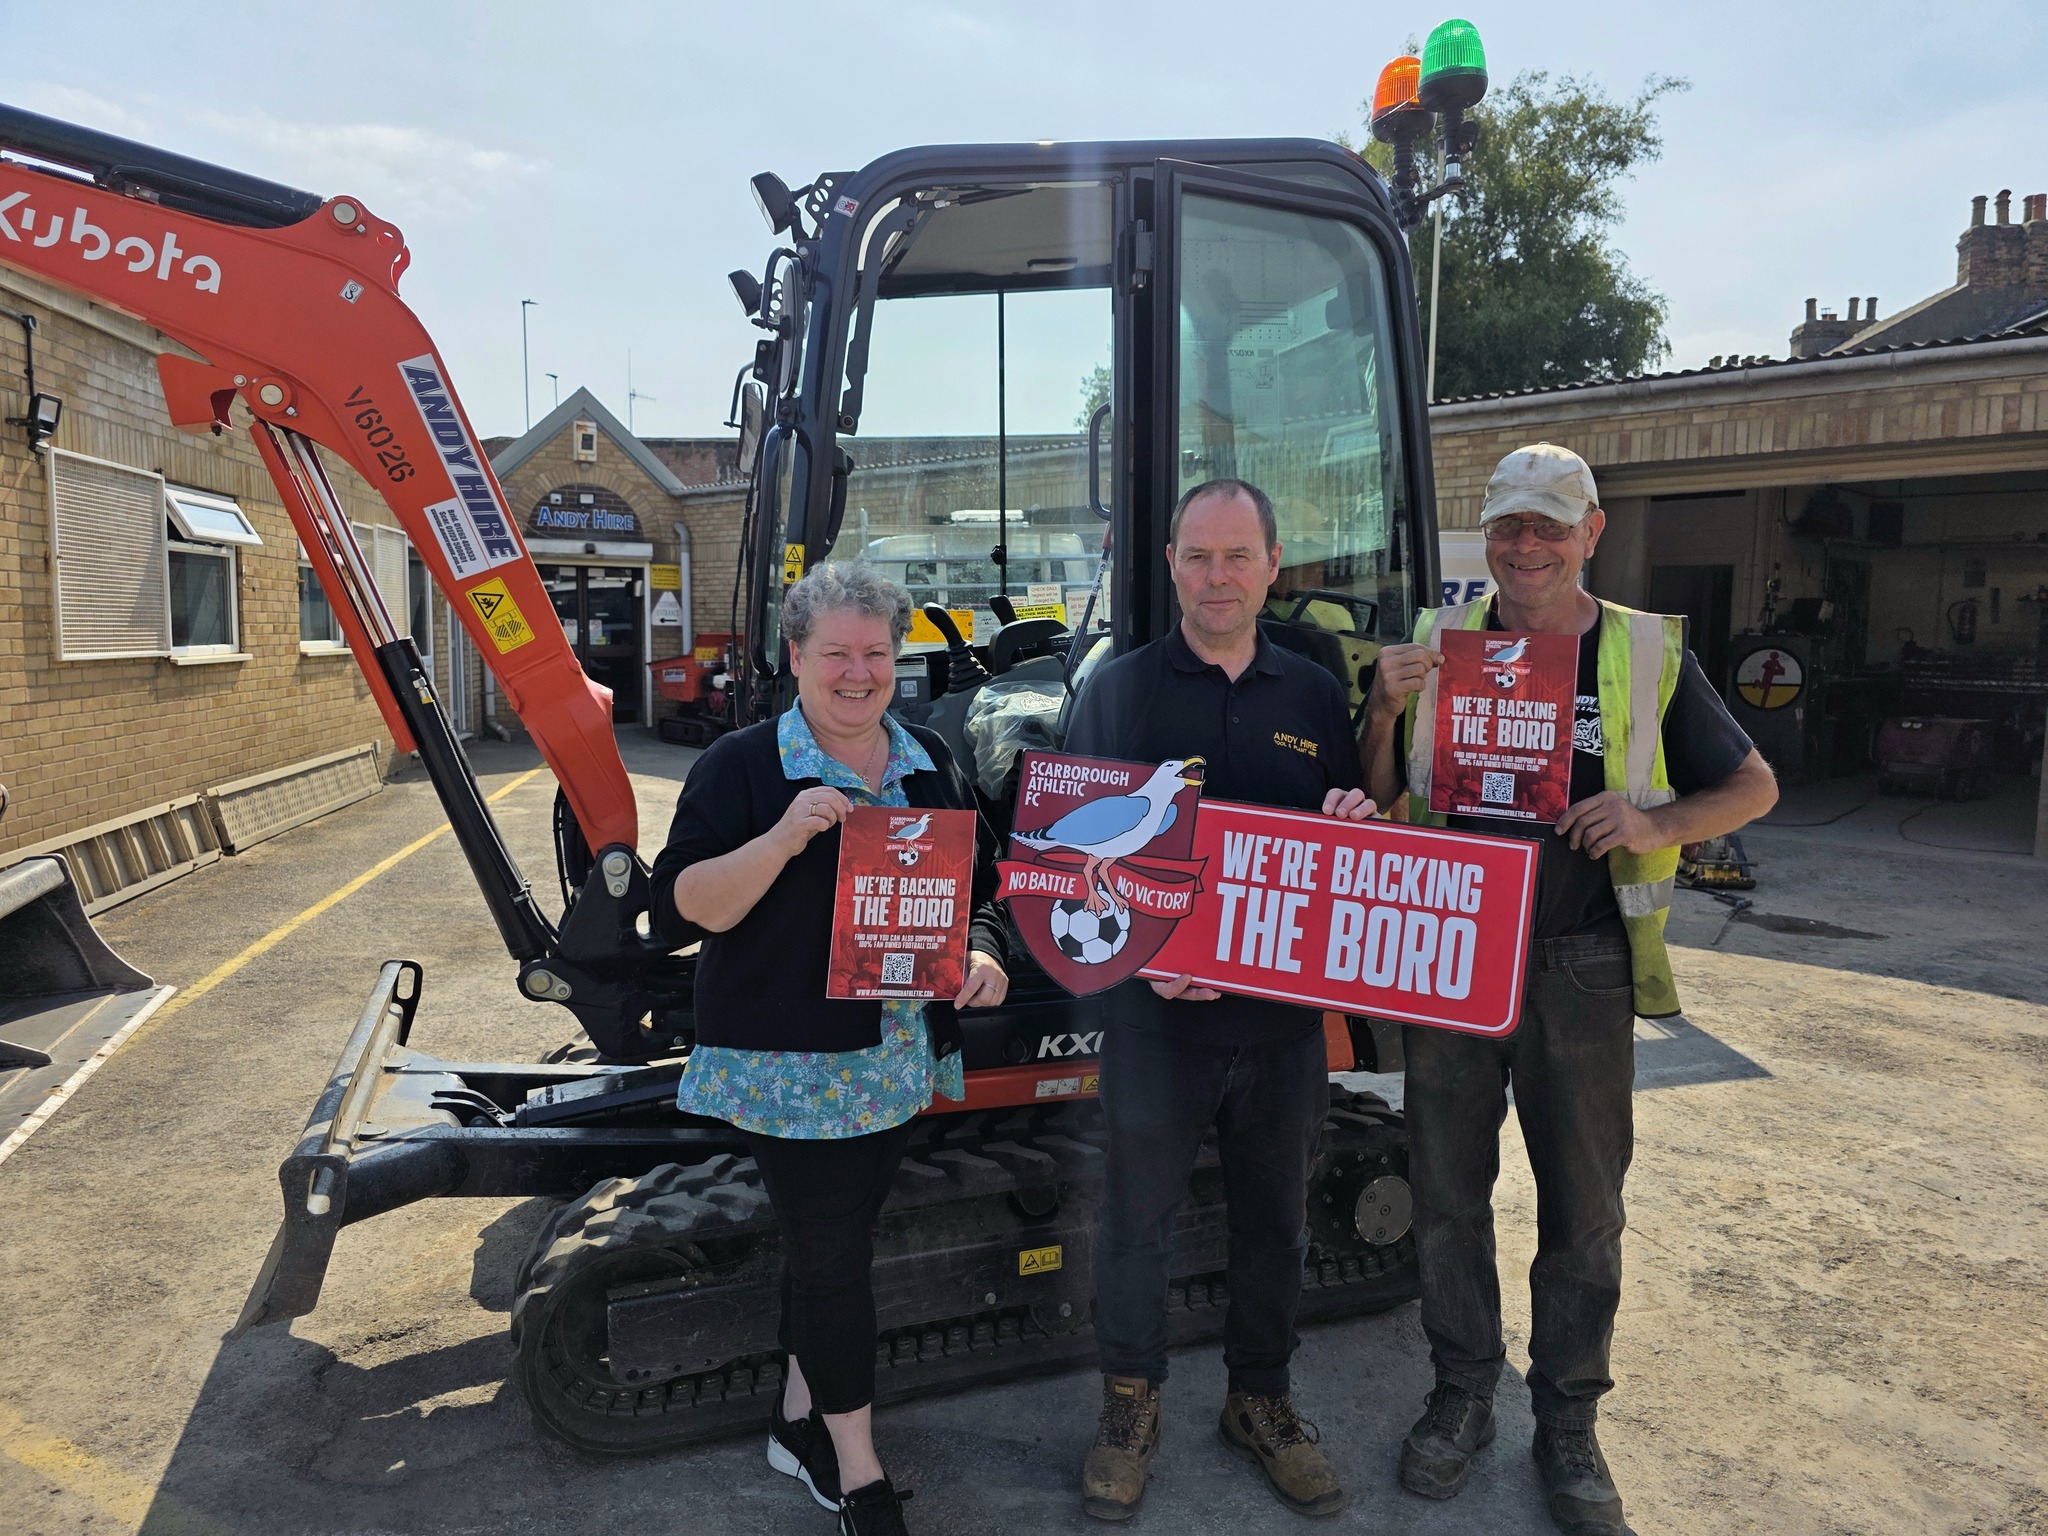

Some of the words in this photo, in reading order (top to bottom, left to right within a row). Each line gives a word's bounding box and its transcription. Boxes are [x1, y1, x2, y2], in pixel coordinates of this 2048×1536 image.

[344, 385, 415, 482] V6026
[402, 365, 481, 473] ANDY
[453, 474, 518, 559] HIRE
[656, 609, 680, 617] ENTRANCE
[1452, 696, 1493, 715] WE'RE
[1497, 699, 1557, 721] BACKING
[1274, 731, 1298, 744] ANDY
[1300, 738, 1318, 752] HIRE
[1451, 715, 1489, 745] THE
[1497, 718, 1556, 750] BORO
[1274, 739, 1287, 747] TOOL
[1293, 745, 1307, 753] PLANT
[1484, 760, 1501, 768] OWNED
[1502, 762, 1525, 770] FOOTBALL
[1514, 756, 1536, 764] SUPPORT
[1030, 760, 1129, 786] SCARBOROUGH
[1027, 776, 1086, 797] ATHLETIC
[1025, 791, 1040, 807] FC
[1008, 871, 1026, 891] NO
[1029, 872, 1076, 895] BATTLE
[1222, 830, 1322, 891] WE'RE
[1330, 845, 1484, 914] BACKING
[854, 876, 895, 895] WE'RE
[898, 877, 956, 897] BACKING
[1117, 875, 1133, 898] NO
[1135, 882, 1190, 910] VICTORY
[852, 896, 891, 926] THE
[898, 898, 954, 928] BORO
[859, 940, 872, 948] 100%
[890, 934, 900, 942] CAN
[1216, 882, 1309, 974] THE
[1324, 899, 1477, 1000] BORO
